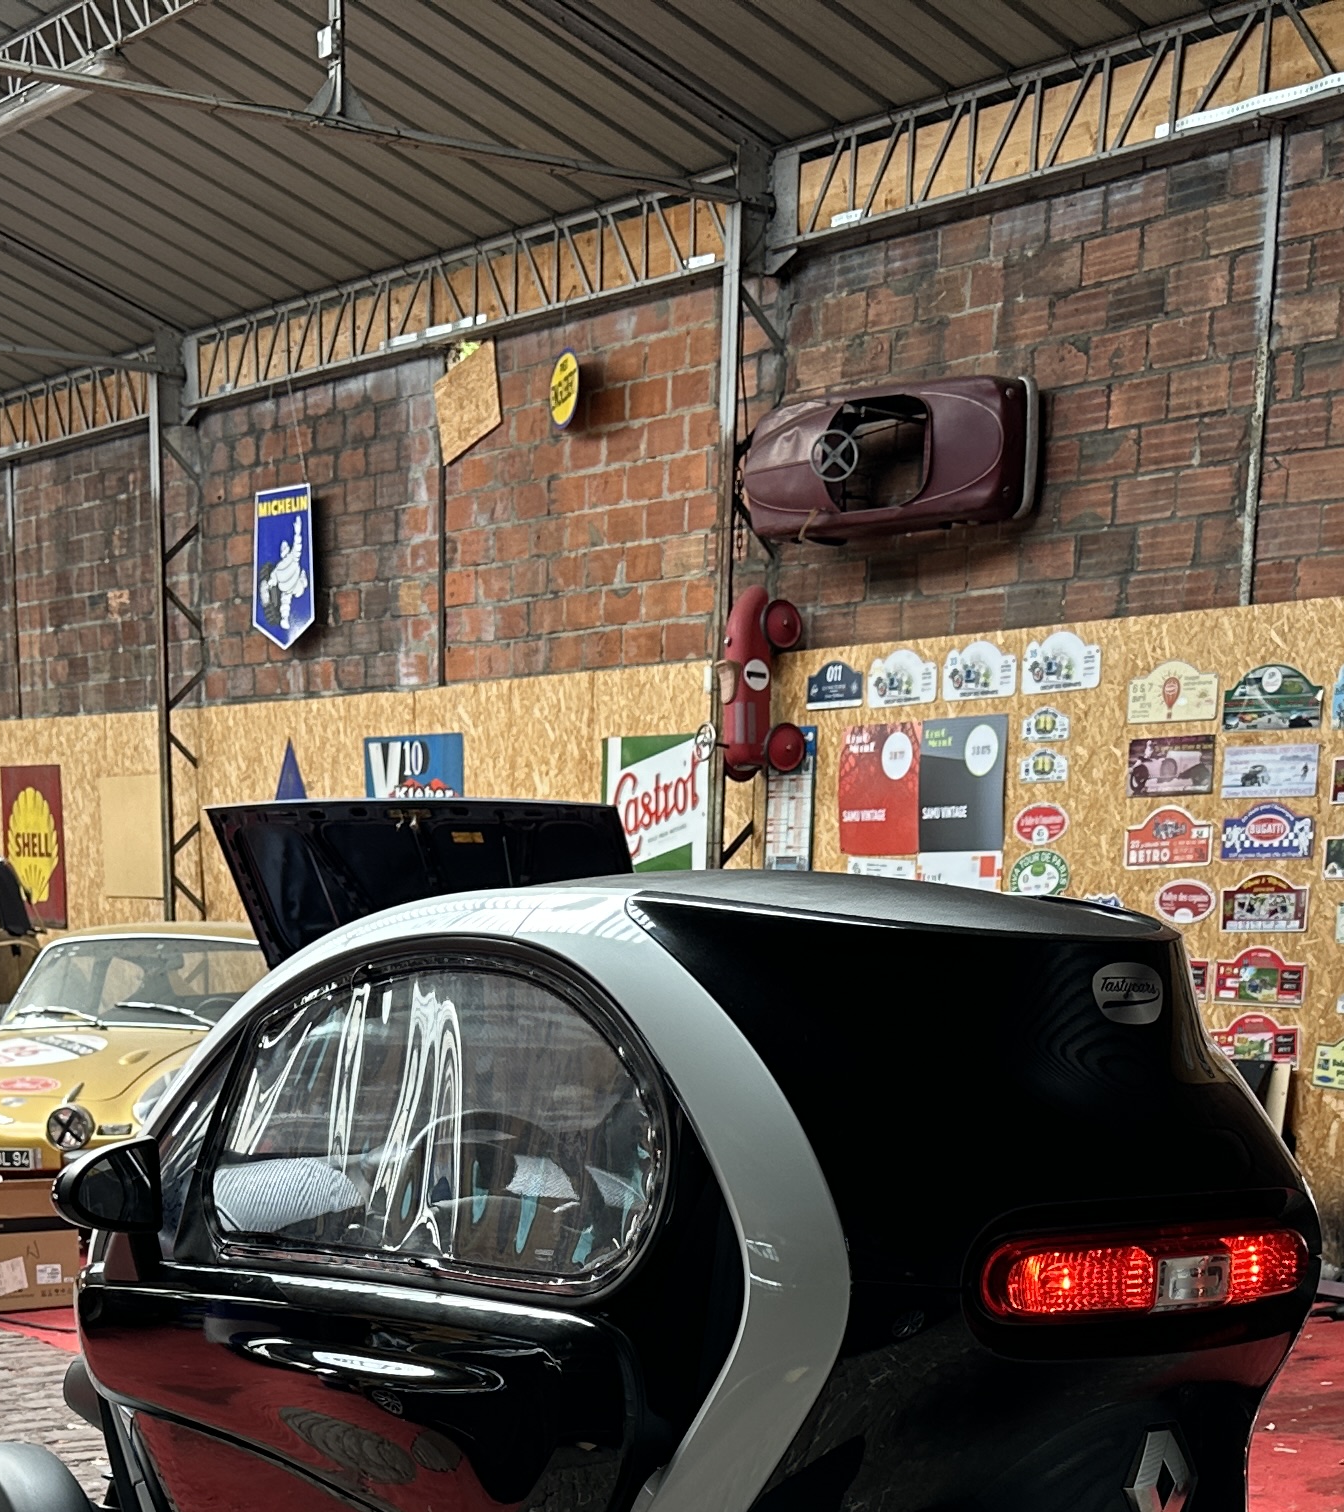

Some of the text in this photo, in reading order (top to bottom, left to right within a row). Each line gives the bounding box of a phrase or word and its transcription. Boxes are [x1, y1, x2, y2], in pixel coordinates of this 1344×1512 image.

[258, 495, 308, 518] MICHELIN
[614, 745, 702, 859] Castrol
[1248, 822, 1284, 835] BUGATTI
[15, 832, 52, 858] SHELL
[1040, 851, 1052, 863] DE
[1129, 848, 1170, 864] RETRO
[1101, 976, 1156, 999] Tastycars
[13, 1151, 29, 1167] 94
